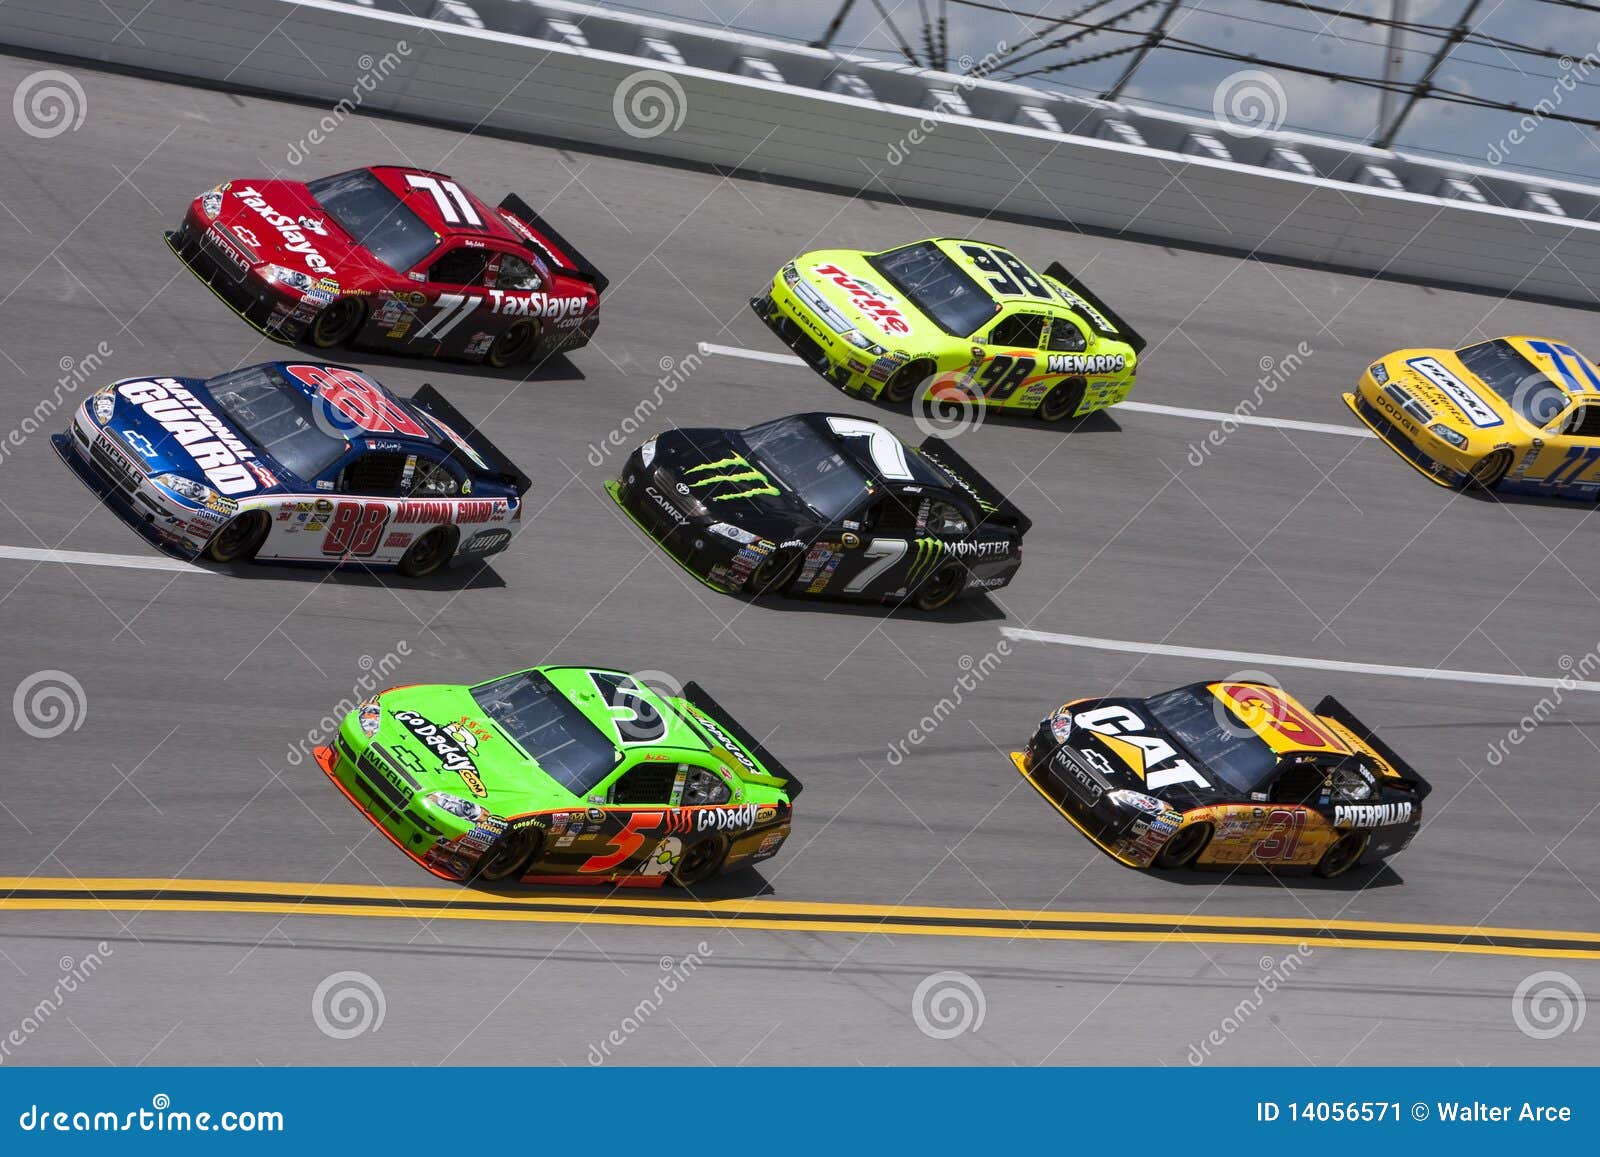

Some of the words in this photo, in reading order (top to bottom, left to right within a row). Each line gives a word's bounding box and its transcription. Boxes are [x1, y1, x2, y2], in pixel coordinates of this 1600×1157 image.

[405, 174, 482, 226] 71
[206, 227, 250, 273] IMPALA
[233, 187, 337, 275] TaxSlayer
[959, 245, 1053, 299] 98
[413, 293, 484, 339] 71
[489, 290, 588, 323] TaxSlayer
[783, 298, 834, 347] FUSION
[816, 265, 909, 333] Turtle
[981, 355, 1036, 400] 98
[1047, 354, 1125, 374] MENARDS
[1525, 340, 1600, 391] 77
[153, 377, 256, 461] NATIONAL
[286, 365, 429, 438] 88
[1376, 396, 1420, 434] DODGE
[95, 434, 144, 483] IMPALA
[118, 381, 257, 495] GUARD
[826, 417, 915, 480] 7
[322, 502, 391, 556] 88
[394, 502, 453, 524] NATIONAL
[456, 502, 493, 524] GUARD
[645, 487, 690, 525] CAMRY
[843, 538, 908, 592] 7
[585, 670, 669, 745] 5
[1074, 705, 1211, 790] CAT
[363, 747, 415, 800] IMPALA
[1055, 750, 1103, 797] IMPALA
[468, 830, 496, 844] MAHLE
[477, 822, 503, 835] MOOG
[1254, 811, 1307, 859] 31
[1334, 802, 1412, 827] CATERPILLAR
[577, 812, 664, 872] 5
